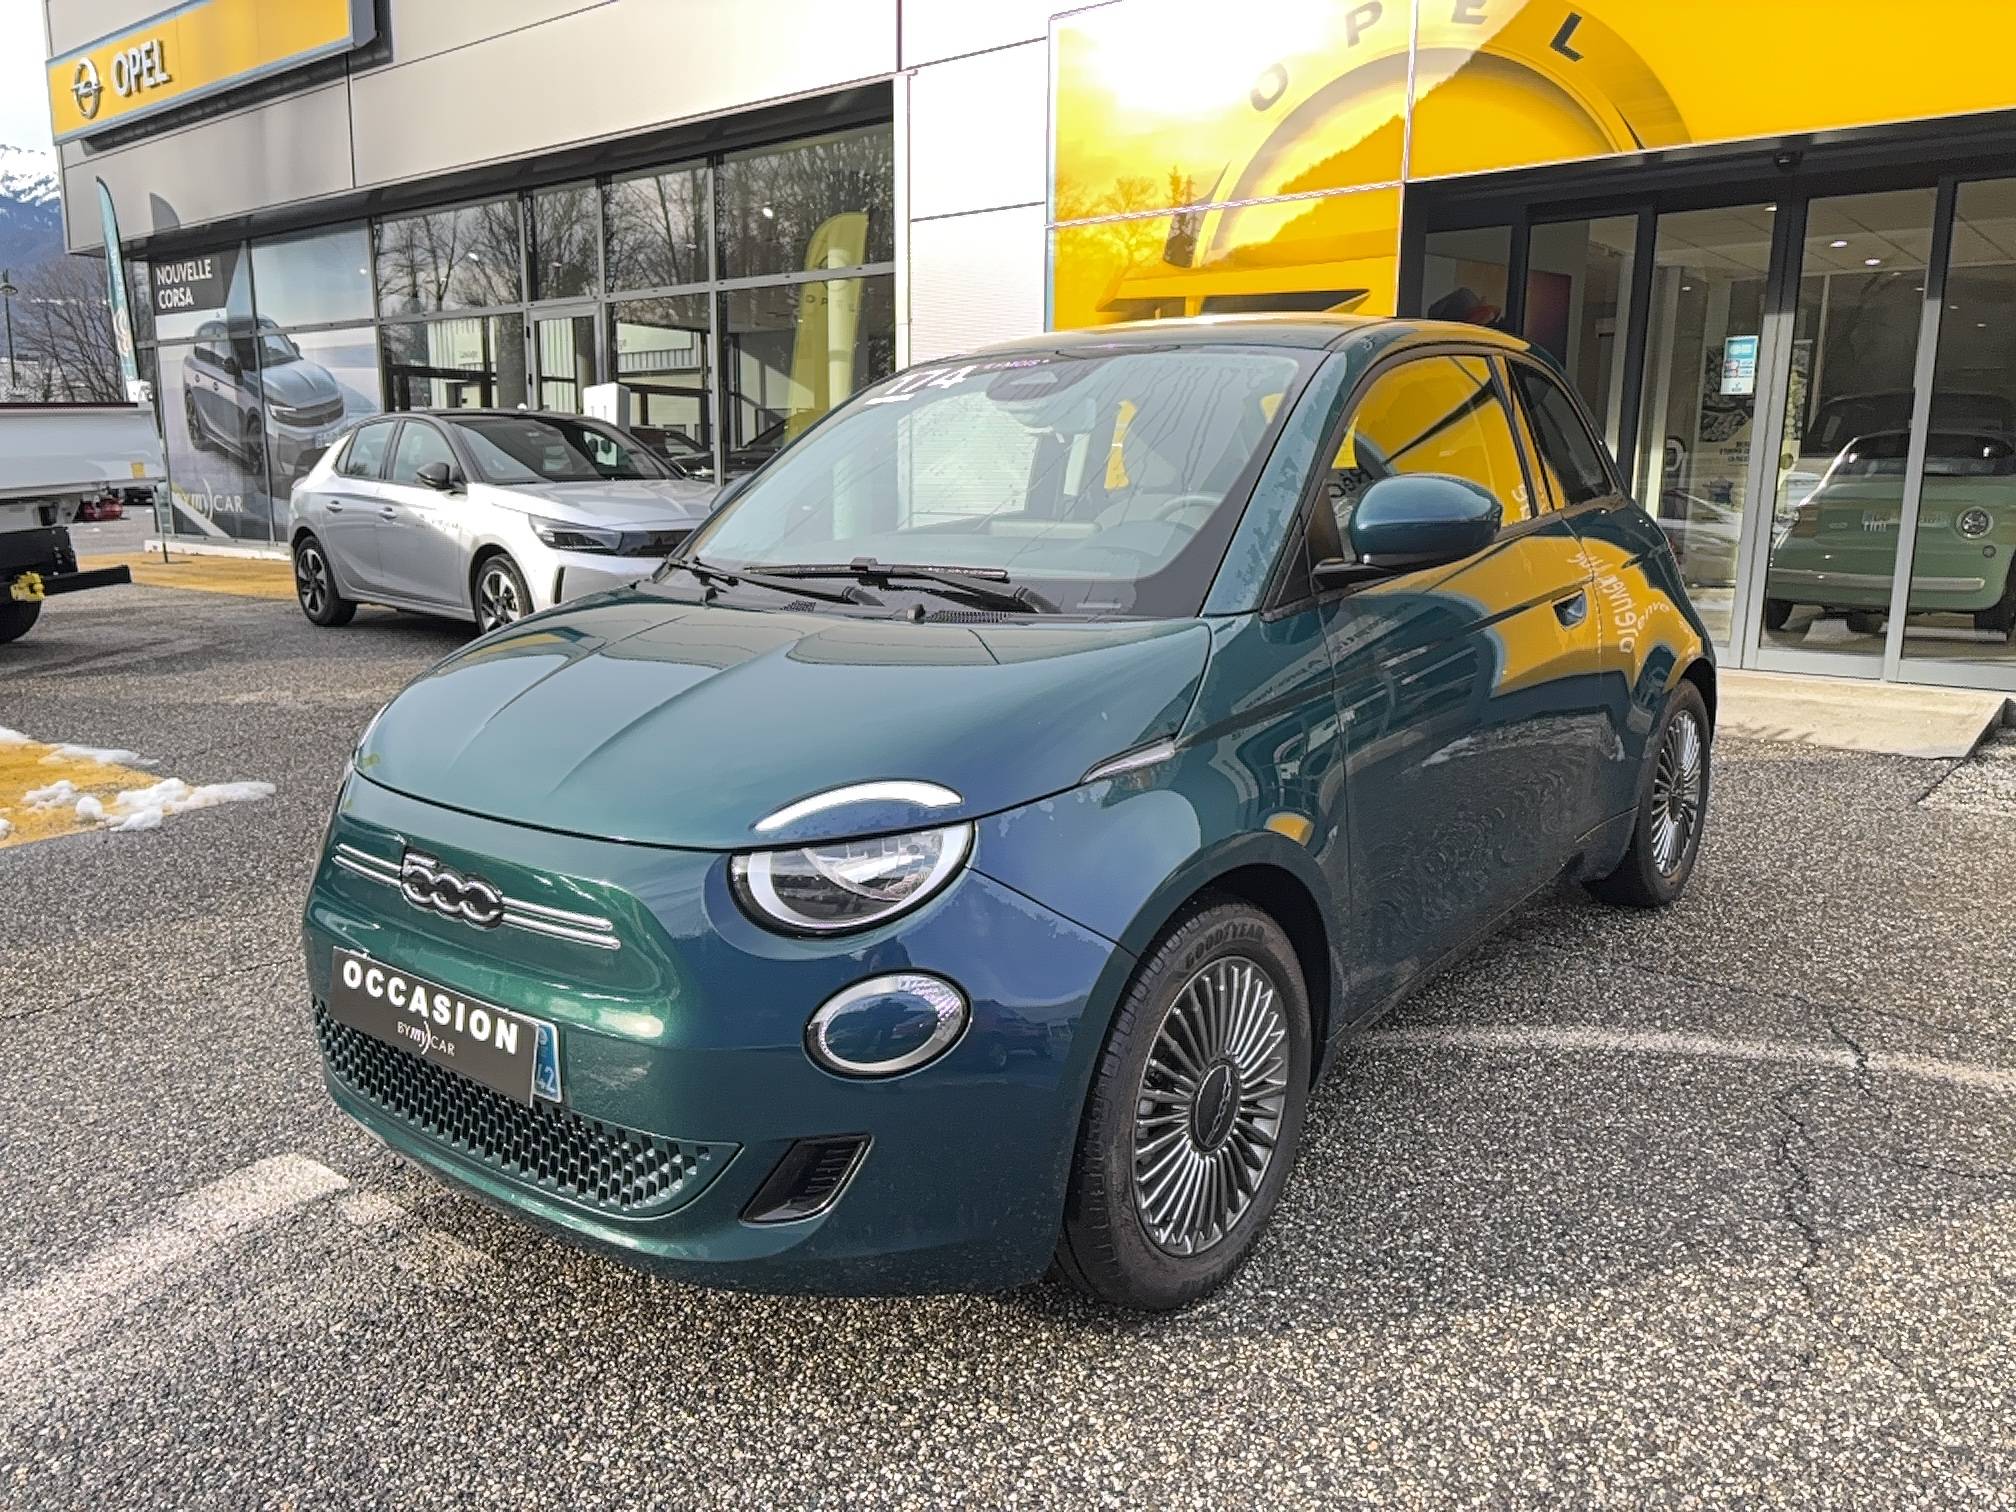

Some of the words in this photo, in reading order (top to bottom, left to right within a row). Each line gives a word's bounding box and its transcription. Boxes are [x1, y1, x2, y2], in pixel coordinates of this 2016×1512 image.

[111, 39, 170, 97] OPEL
[1250, 0, 1584, 112] OPEL
[156, 258, 212, 286] NOUVELLE
[159, 286, 194, 309] CORSA
[402, 852, 501, 923] 500
[343, 960, 518, 1054] OCCASION
